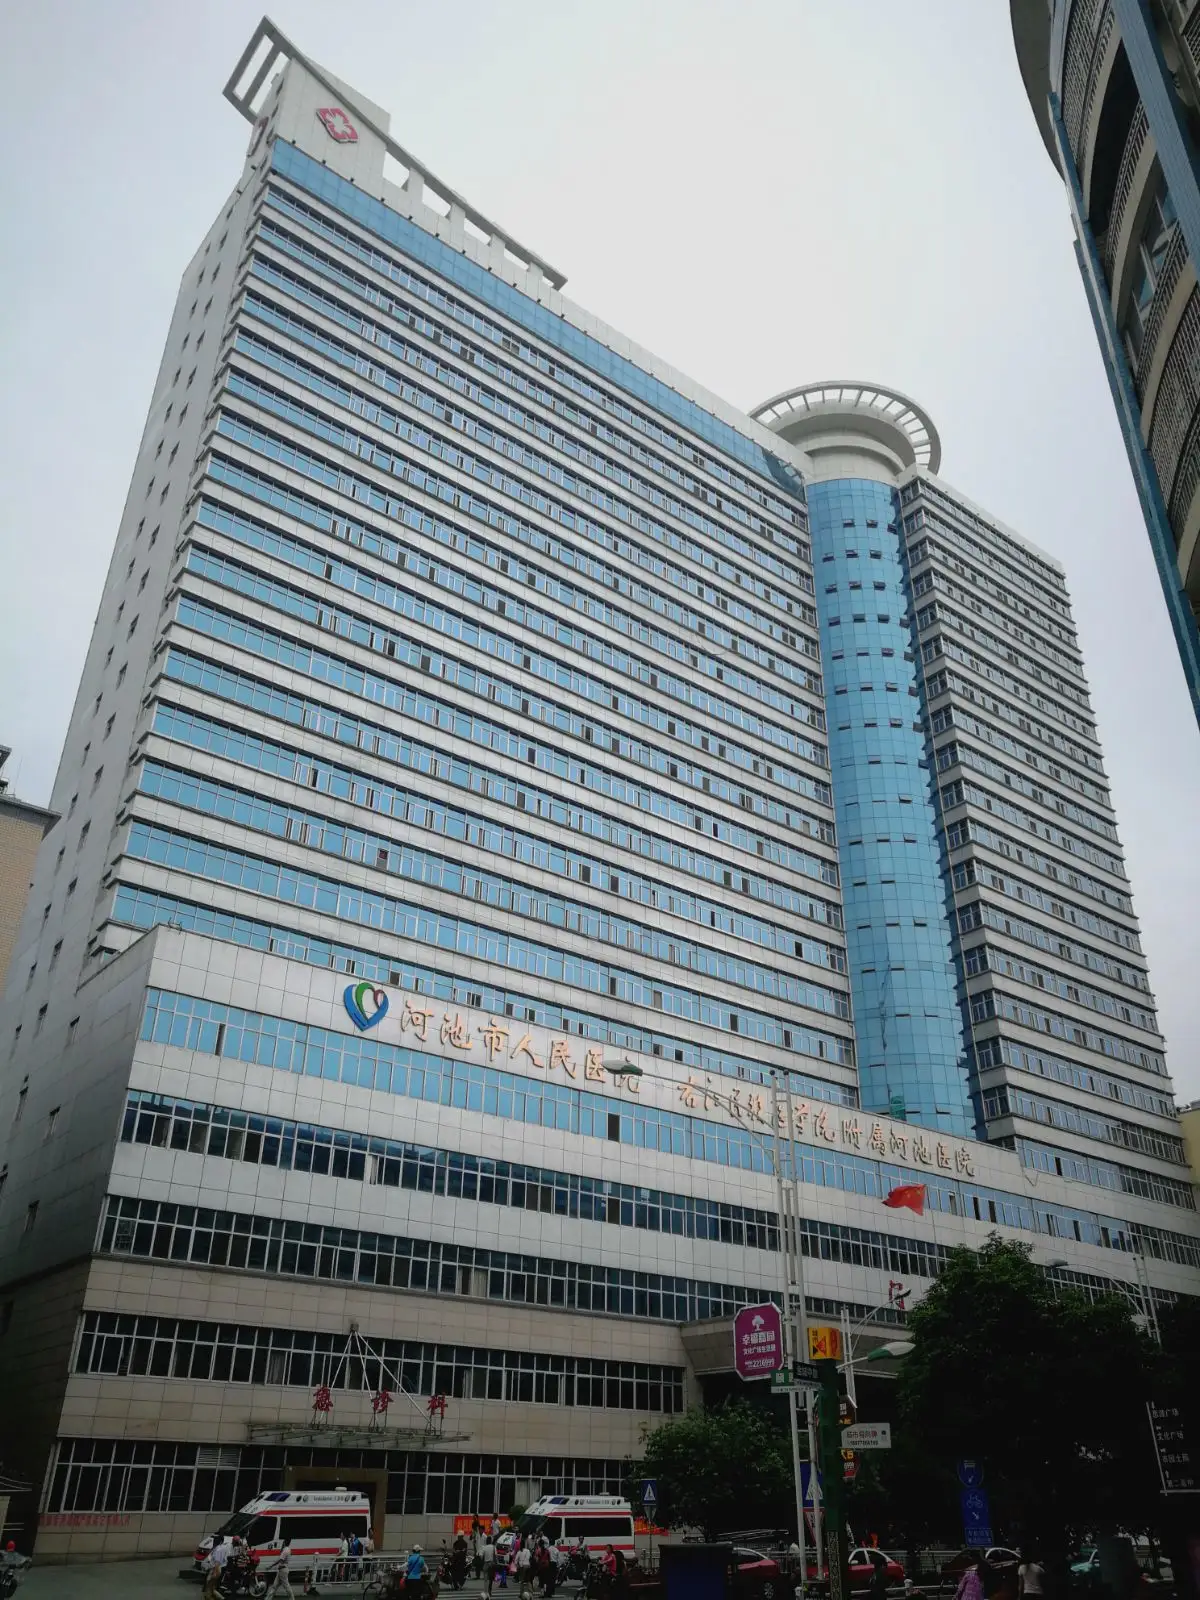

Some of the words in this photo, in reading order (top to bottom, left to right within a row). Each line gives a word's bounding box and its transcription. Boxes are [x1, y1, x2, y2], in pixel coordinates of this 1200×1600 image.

[401, 1000, 640, 1093] 河池市人民医院
